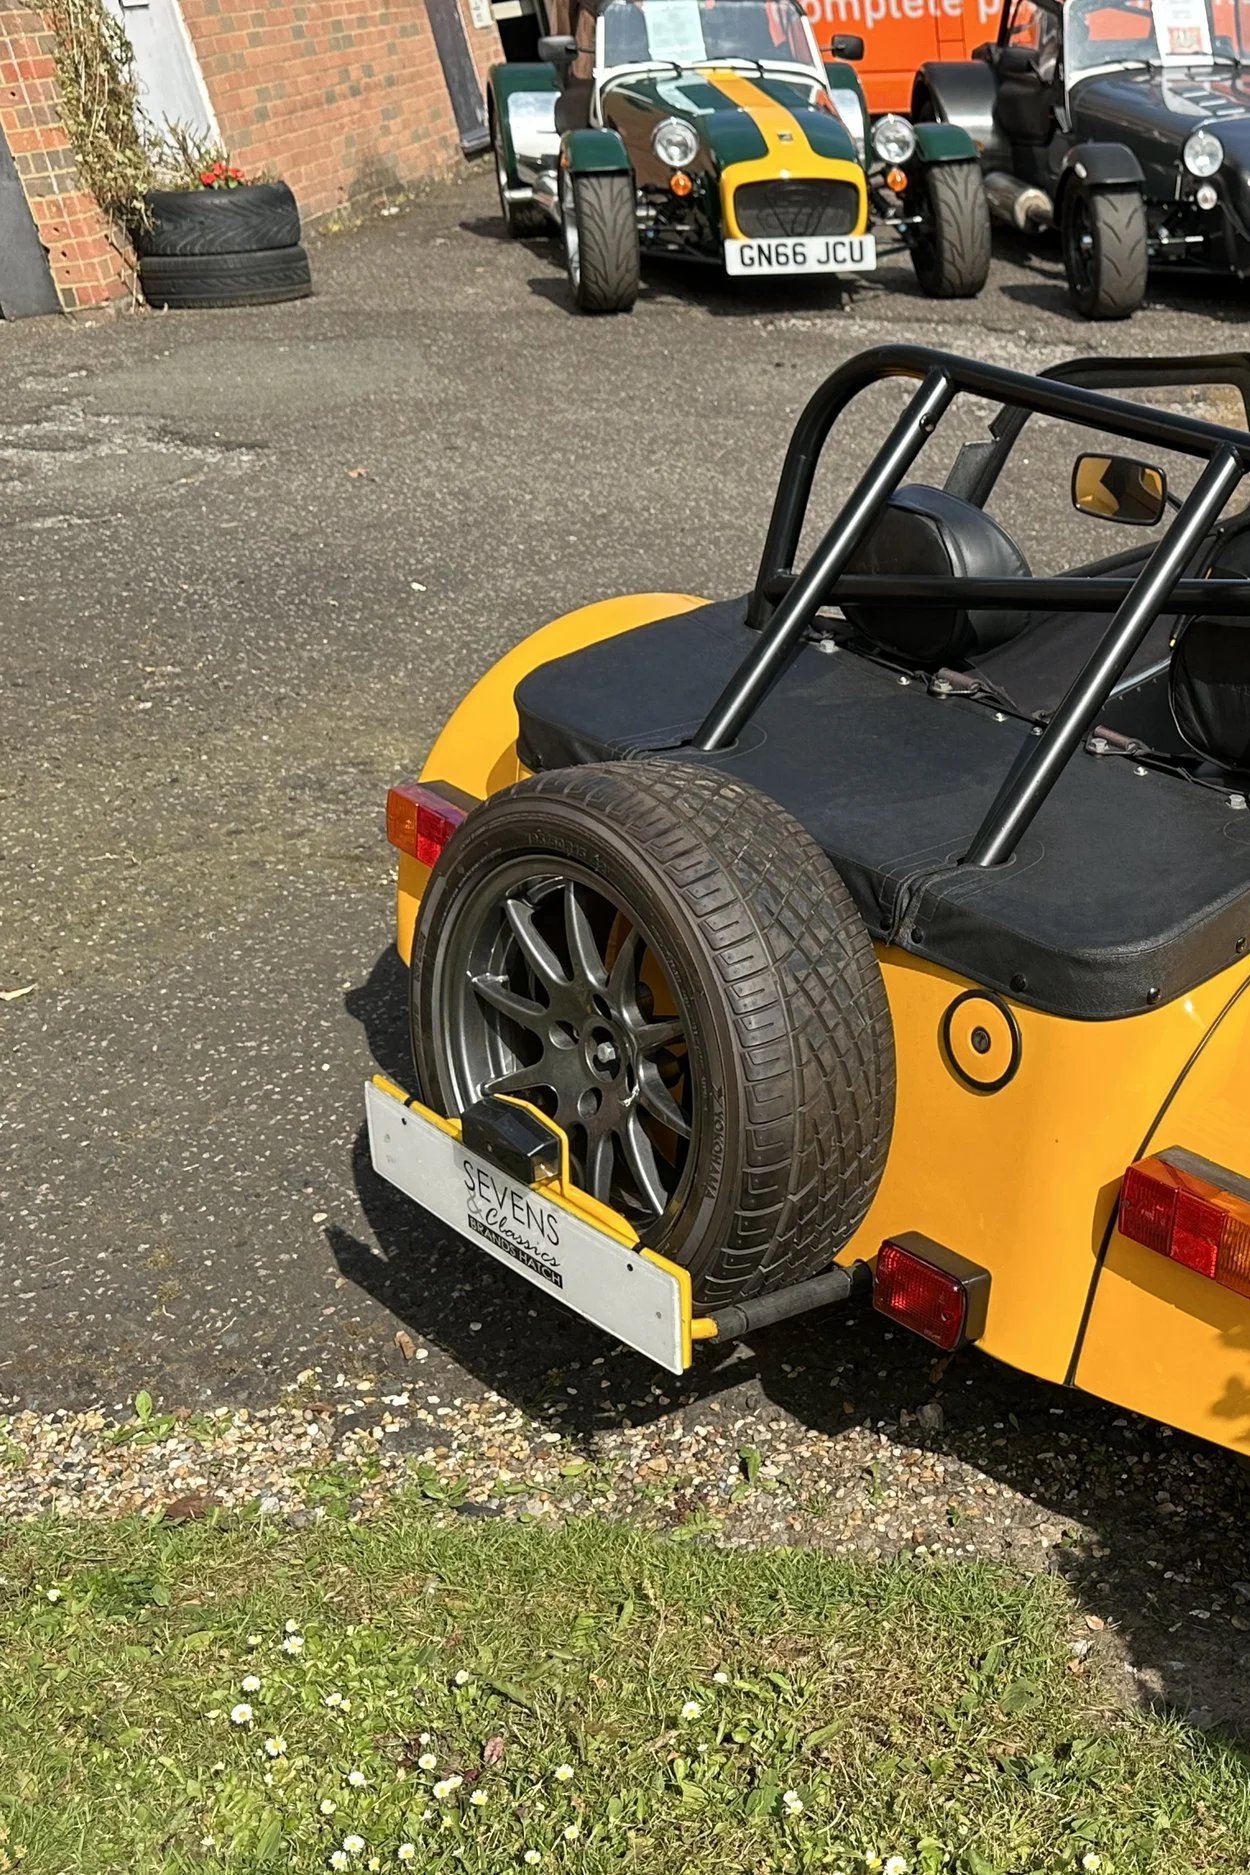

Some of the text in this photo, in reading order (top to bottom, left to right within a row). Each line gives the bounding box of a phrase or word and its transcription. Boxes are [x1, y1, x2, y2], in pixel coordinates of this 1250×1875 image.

[802, 0, 964, 29] omplete
[740, 240, 864, 267] GN66 JCU
[704, 1111, 727, 1200] YOKOHAMA
[463, 1160, 560, 1246] SEVENS
[470, 1216, 562, 1287] BRANDS HATCH
[485, 1208, 561, 1267] Classics
